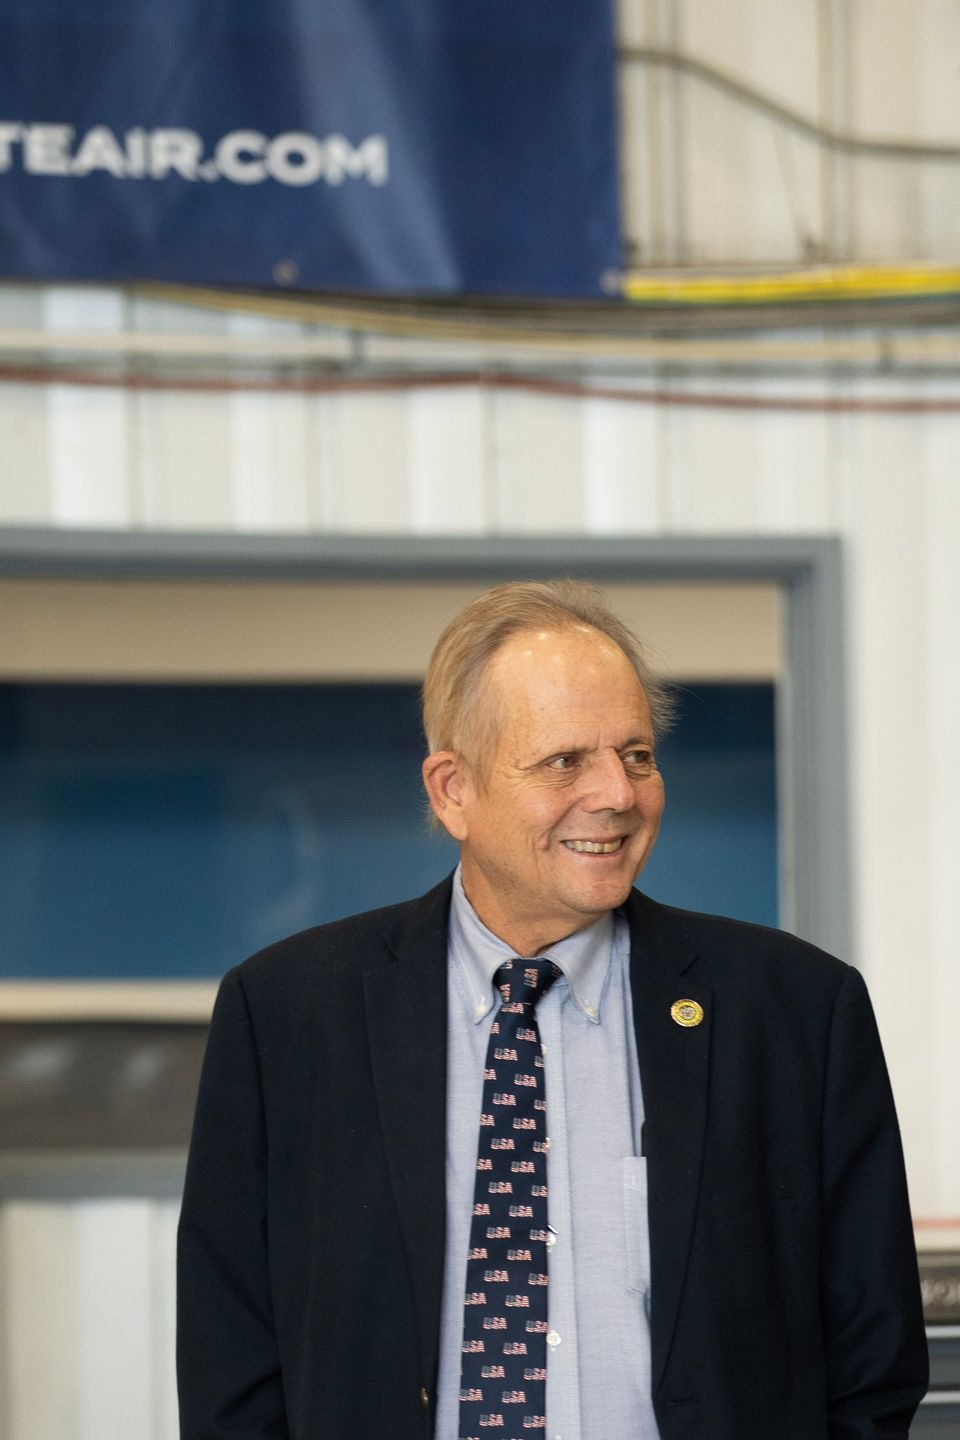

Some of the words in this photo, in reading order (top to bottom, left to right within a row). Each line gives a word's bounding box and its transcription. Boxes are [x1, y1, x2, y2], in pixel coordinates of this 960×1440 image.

[516, 1027, 537, 1042] USA
[494, 1047, 518, 1061] USA
[483, 1068, 496, 1080] SA
[514, 1073, 537, 1088] USA
[492, 1092, 516, 1106] USA
[480, 1113, 495, 1126] SA
[513, 1117, 536, 1130] USA
[490, 1138, 515, 1150] USA
[476, 1158, 492, 1170] SA
[511, 1160, 535, 1173] USA
[488, 1181, 512, 1194] USA
[531, 1185, 548, 1197] US
[473, 1203, 490, 1215] SA
[509, 1205, 533, 1217] USA
[486, 1226, 511, 1239] USA
[507, 1249, 532, 1261] USA
[484, 1270, 509, 1282] USA
[505, 1295, 530, 1307] USA
[483, 1317, 507, 1330] USA
[461, 1340, 485, 1353] USA
[503, 1342, 528, 1355] USA
[481, 1365, 505, 1378] USA
[460, 1388, 483, 1401] USA
[501, 1391, 526, 1404] USA
[479, 1414, 504, 1427] USA
